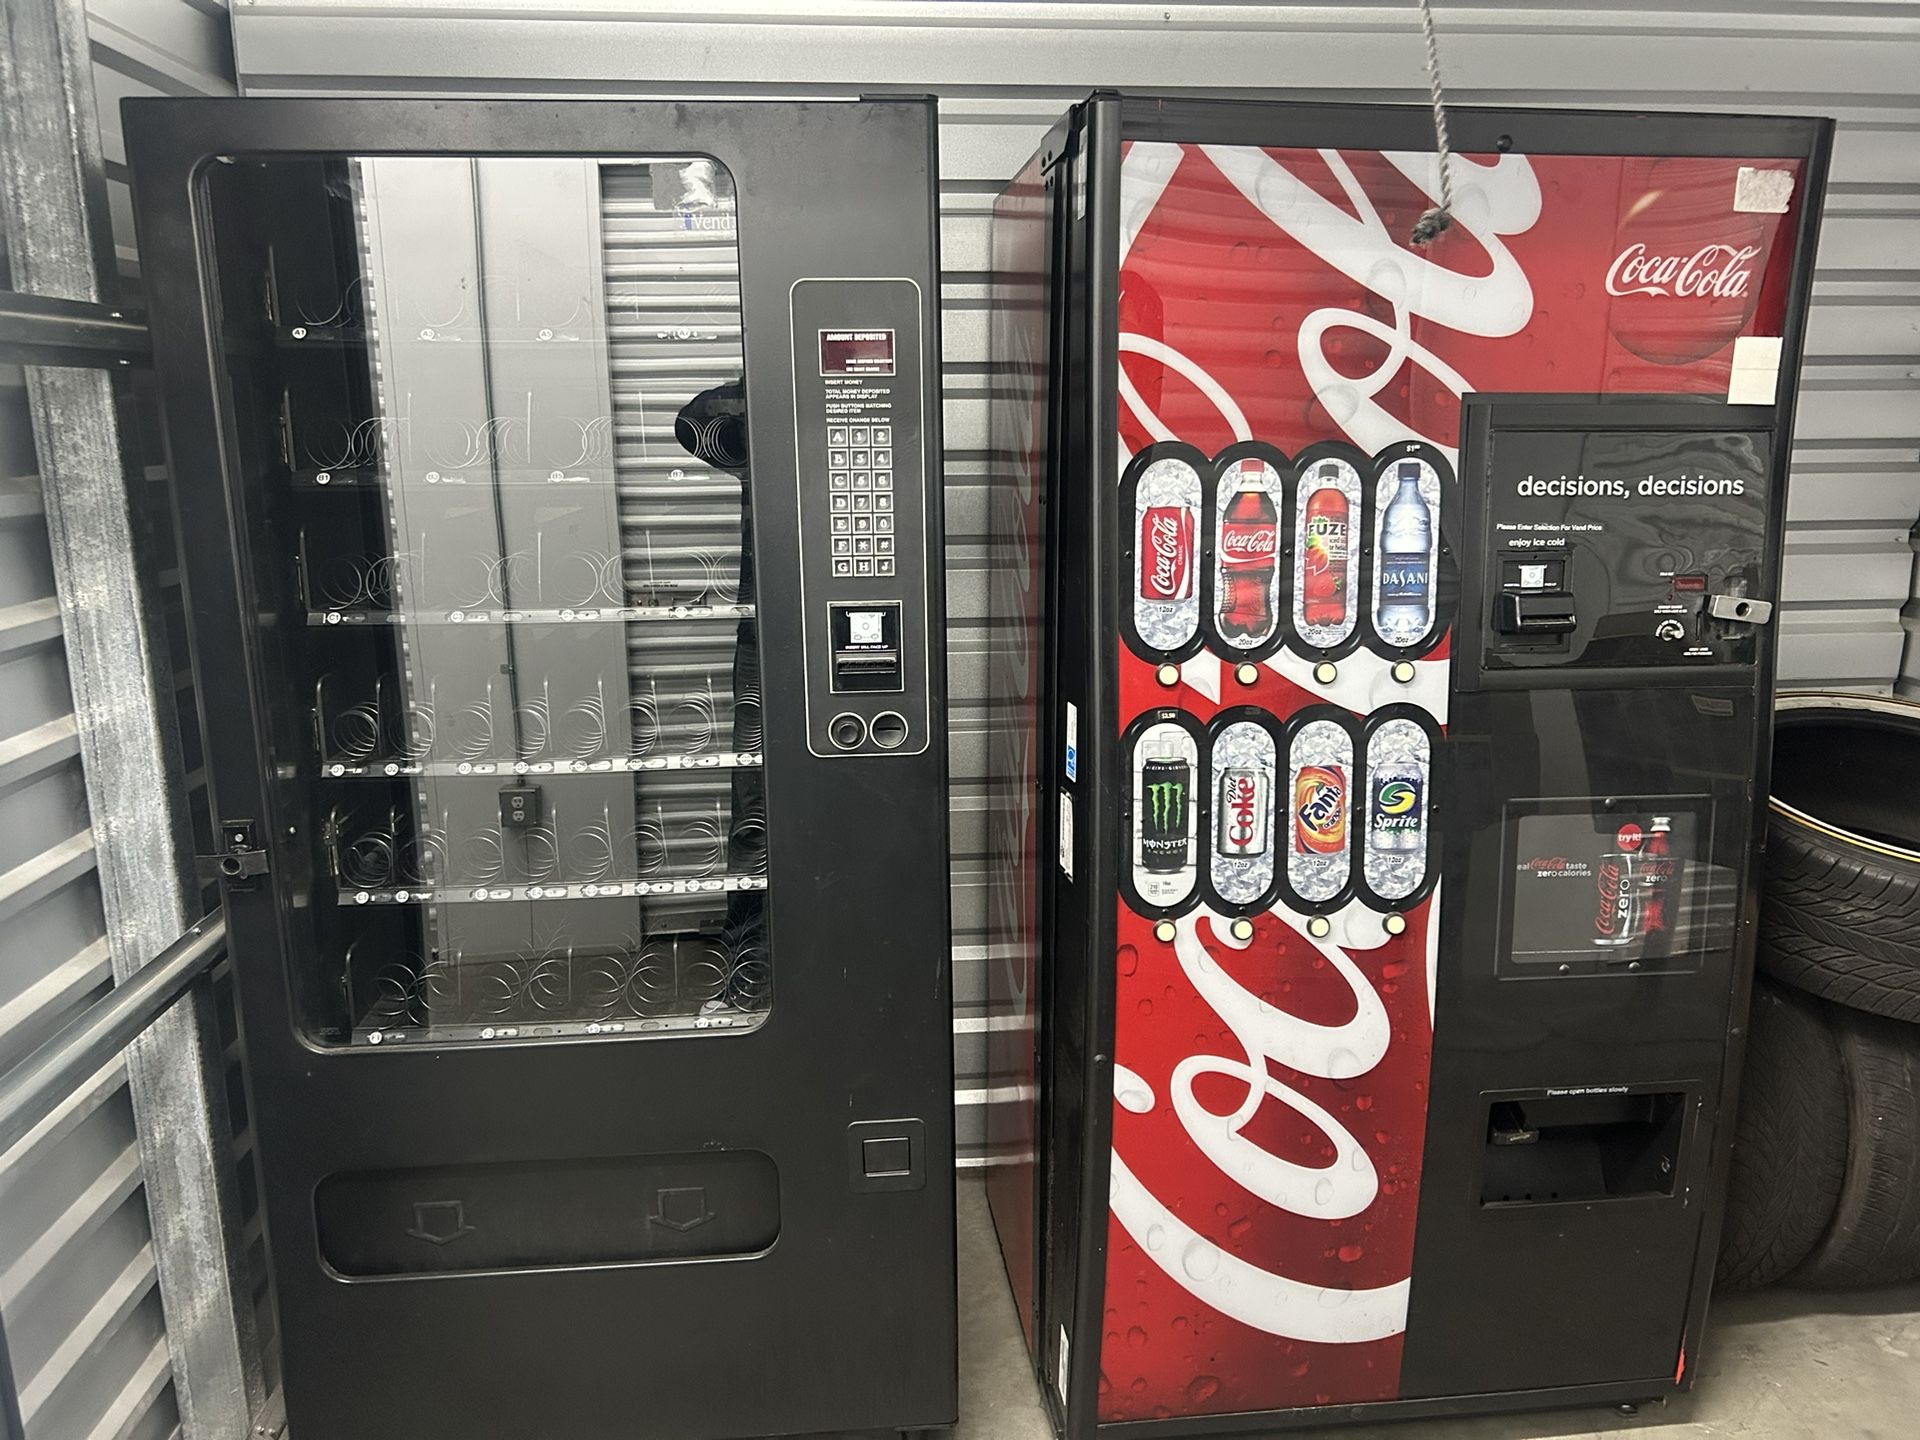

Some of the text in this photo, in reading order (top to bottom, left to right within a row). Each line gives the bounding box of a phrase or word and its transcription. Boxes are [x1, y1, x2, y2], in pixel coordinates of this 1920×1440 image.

[1604, 243, 1762, 297] Coca-Cola
[826, 333, 887, 341] AMOUNT DEPOSITED
[1517, 475, 1744, 499] decisions, decisions
[1308, 523, 1347, 536] FUZE
[1223, 529, 1276, 553] Coca-Cola
[1508, 538, 1565, 547] enjoy ice cold
[1150, 513, 1178, 596] Coca-Cola
[1382, 569, 1428, 587] DASANI
[1226, 777, 1237, 804] Diet
[1229, 776, 1256, 846] Coke
[1299, 786, 1342, 832] Fanta
[1374, 813, 1418, 831] Sprite
[1142, 837, 1188, 850] MONSTER
[1617, 834, 1632, 843] try
[1558, 869, 1592, 877] calories
[1566, 862, 1588, 870] taste
[1645, 874, 1668, 882] zero
[1594, 863, 1620, 934] Coca-Cola
[1617, 879, 1630, 919] zero
